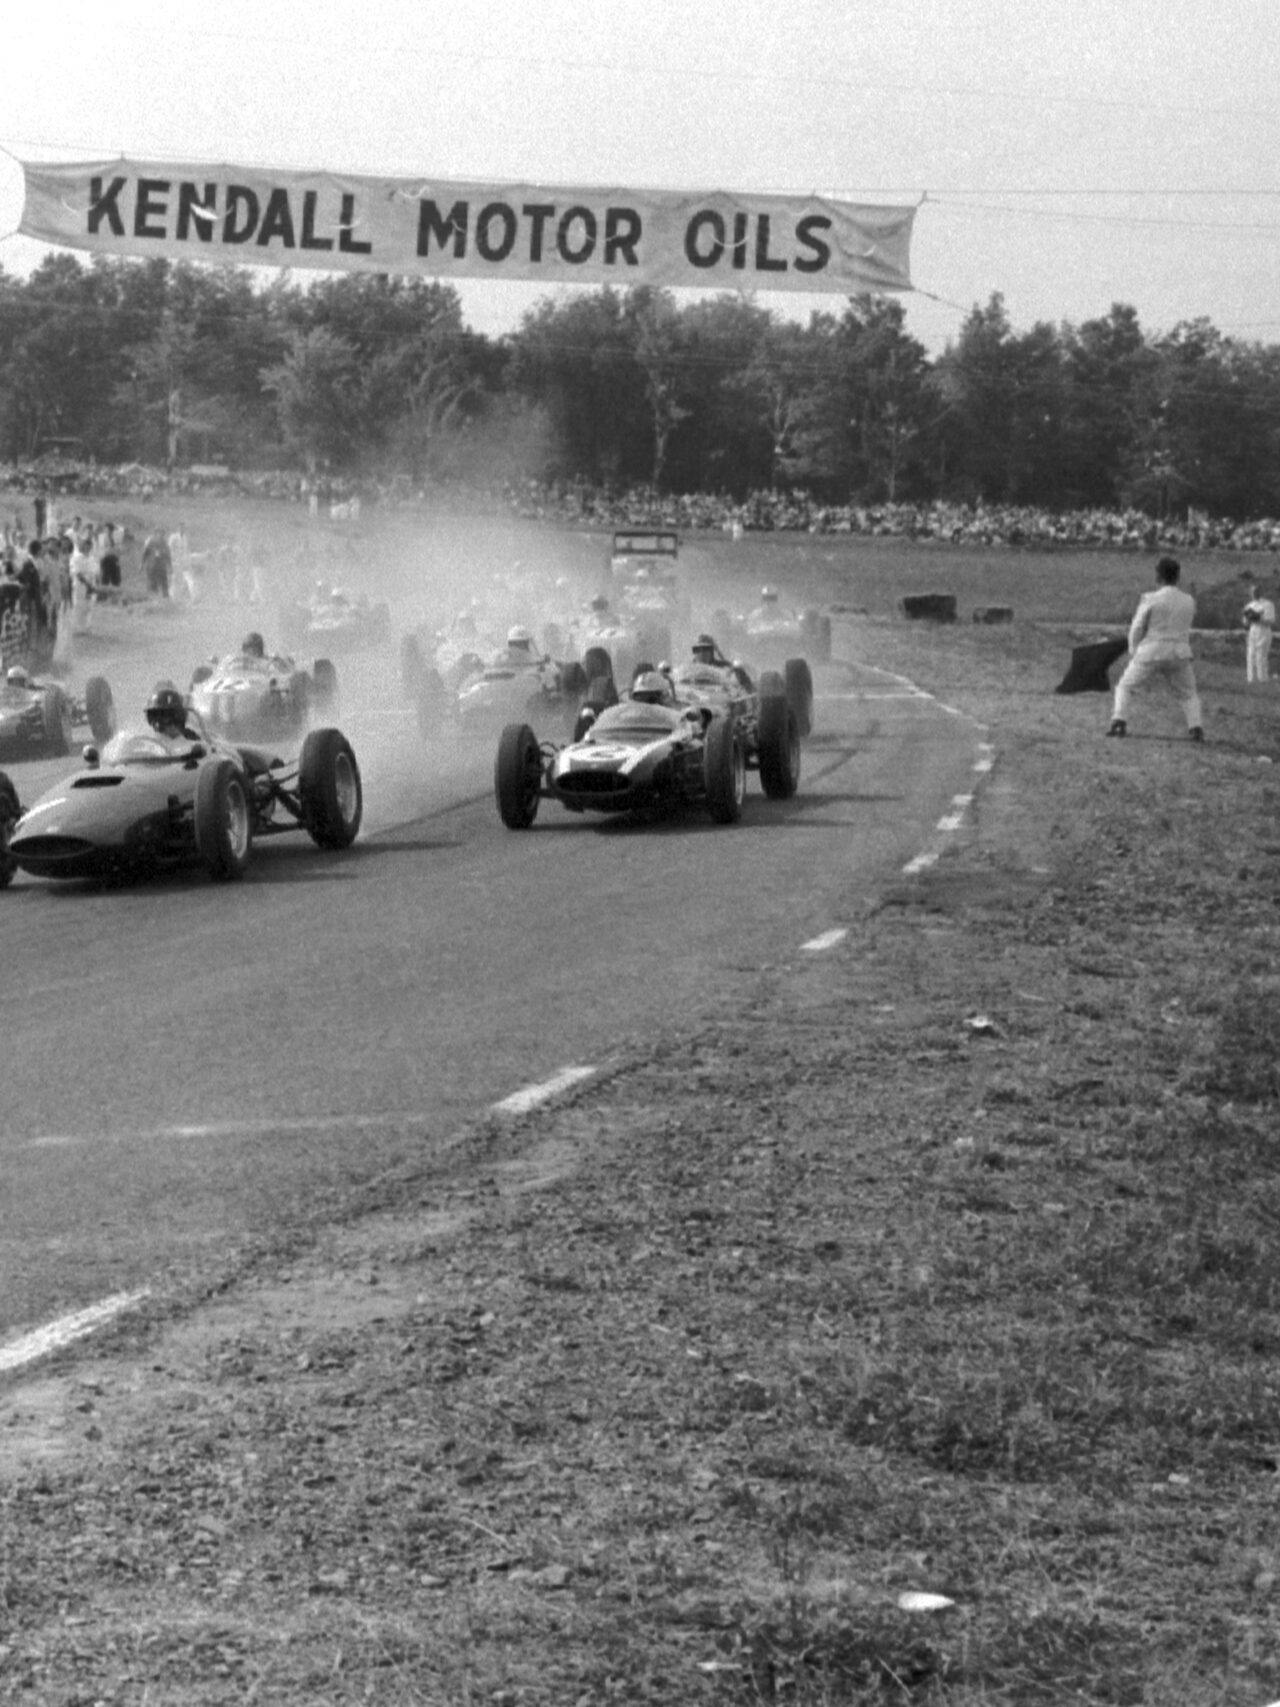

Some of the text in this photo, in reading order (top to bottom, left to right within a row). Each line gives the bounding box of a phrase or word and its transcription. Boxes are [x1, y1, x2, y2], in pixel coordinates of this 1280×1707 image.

[87, 176, 832, 273] KENDALL MOTOR OILS
